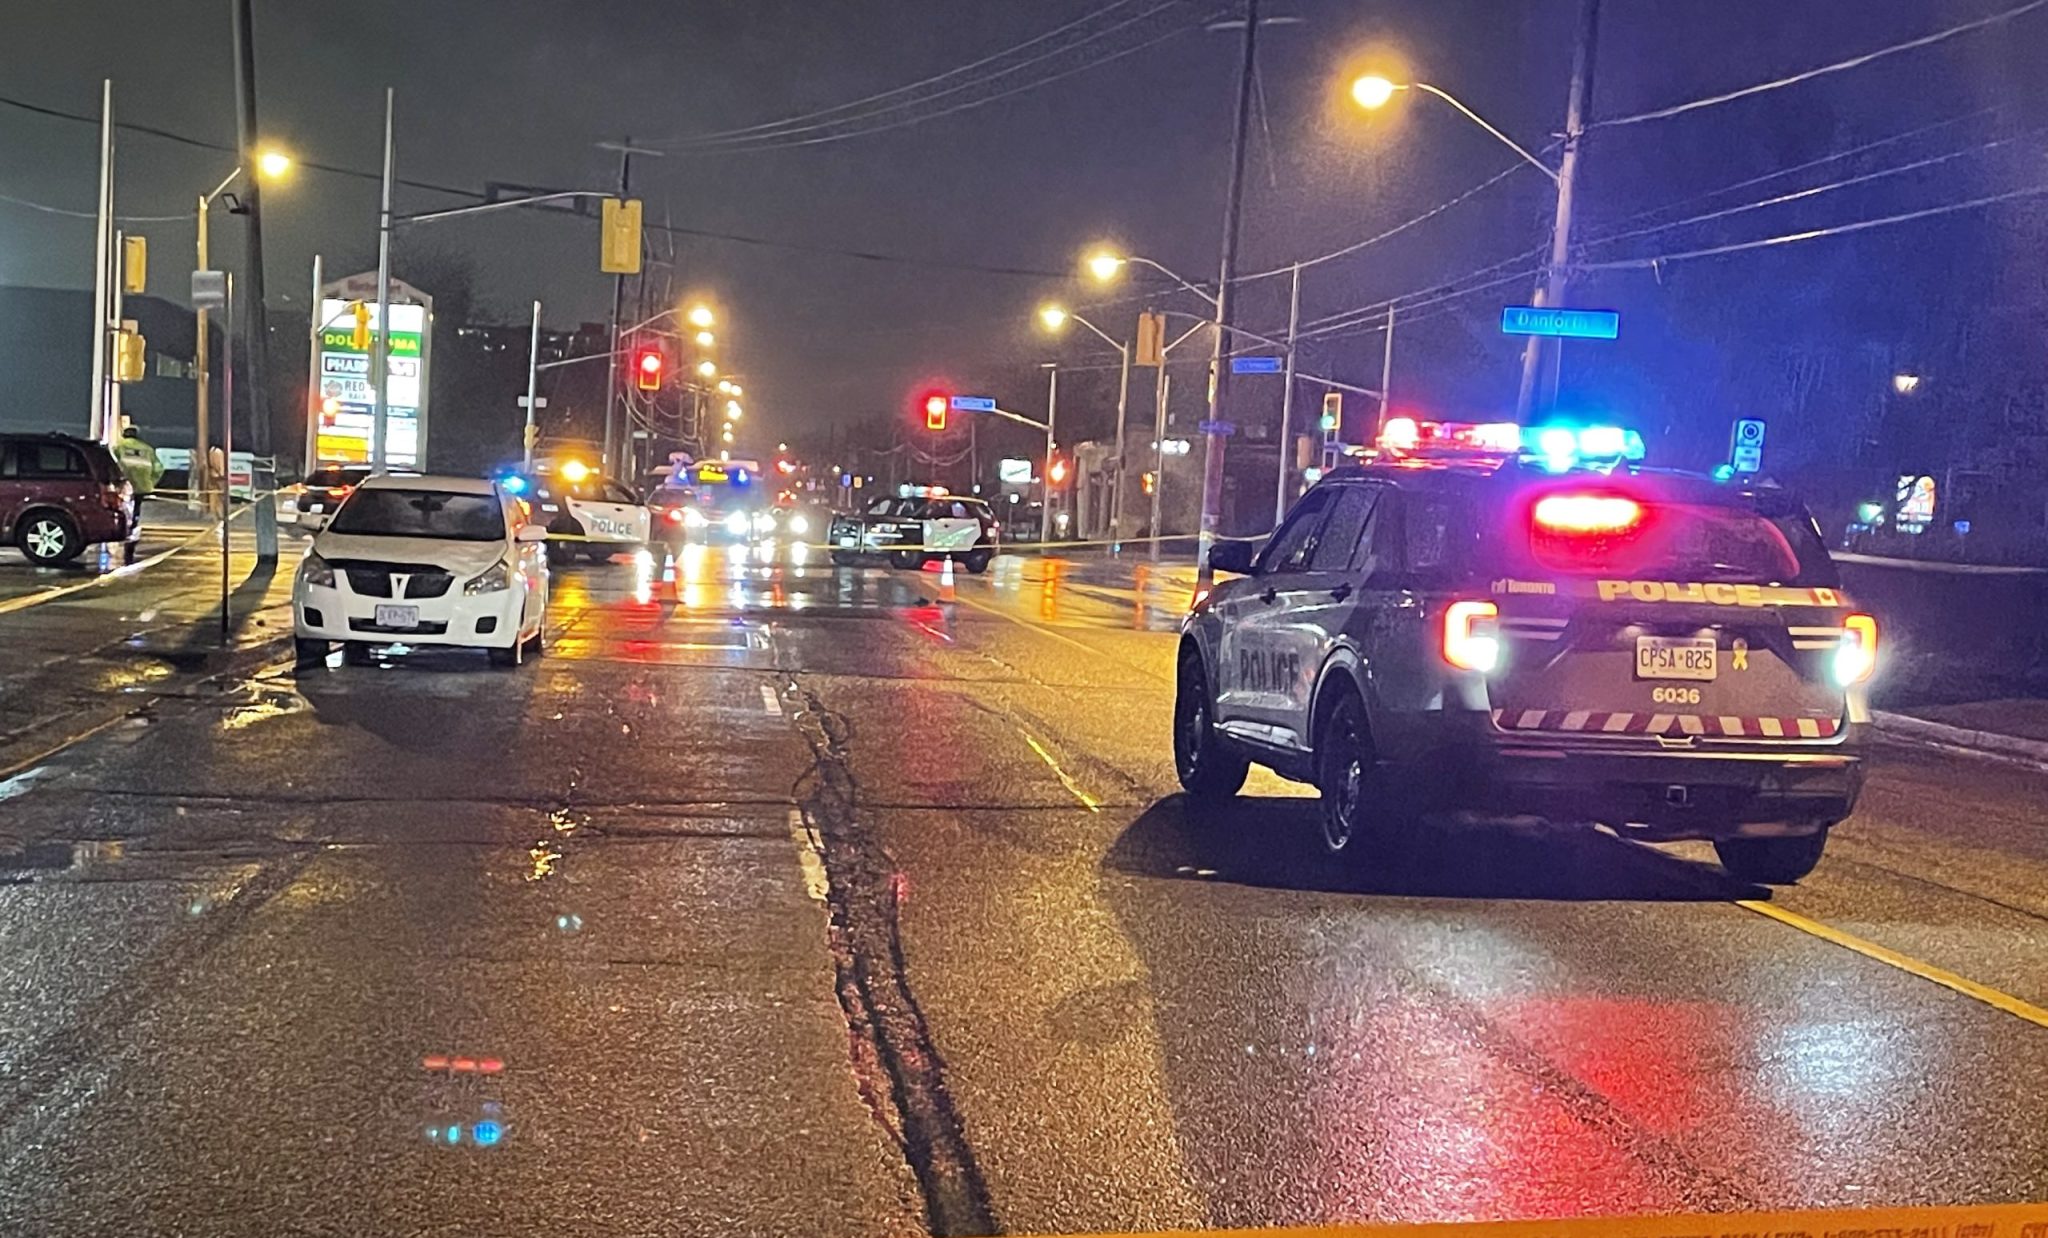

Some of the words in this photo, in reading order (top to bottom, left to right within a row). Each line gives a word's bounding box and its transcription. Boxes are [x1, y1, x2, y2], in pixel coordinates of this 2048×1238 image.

[590, 519, 633, 535] POLICE
[1596, 580, 1763, 607] POLICE
[1640, 647, 1676, 668] CPSA
[1685, 649, 1713, 670] 825
[1652, 687, 1701, 705] 6036
